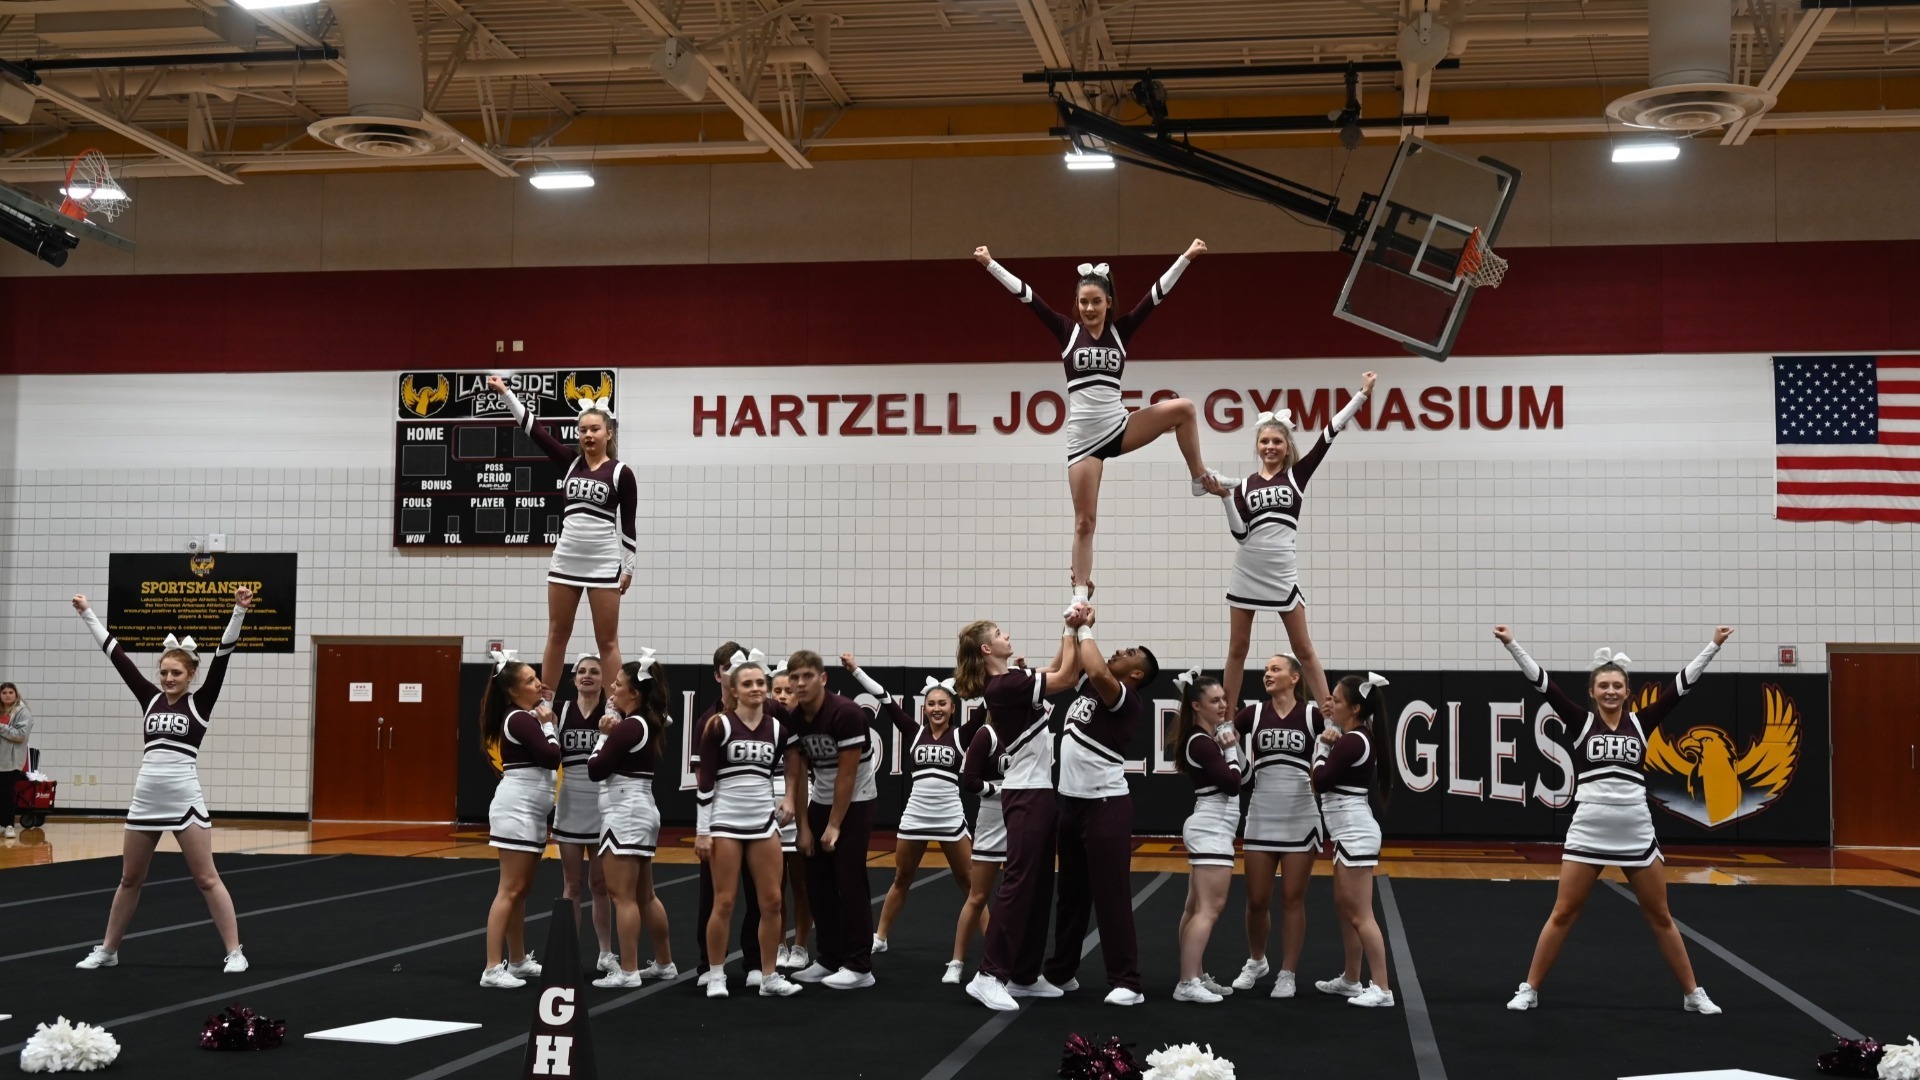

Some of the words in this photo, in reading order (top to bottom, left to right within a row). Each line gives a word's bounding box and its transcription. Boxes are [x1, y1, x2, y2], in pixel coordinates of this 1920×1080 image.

[1073, 347, 1122, 372] GHS
[476, 392, 536, 401] GOEN
[475, 400, 536, 414] EAGS
[692, 392, 977, 437] HARTZELL
[1203, 385, 1564, 432] GYMNASIUM
[406, 427, 444, 441] HOME
[484, 463, 504, 472] POSS
[476, 472, 512, 483] PERIOD
[421, 480, 452, 490] BONUS
[566, 477, 610, 505] GHS
[402, 497, 432, 508] FOULS
[470, 497, 505, 508] PLAYER
[515, 497, 546, 508] FOULS
[1246, 485, 1294, 513] GHS
[406, 534, 425, 543] WON
[444, 534, 462, 544] TOL
[504, 534, 529, 544] GAME
[1068, 695, 1098, 725] HS
[145, 712, 190, 736] GHS
[1257, 728, 1306, 753] GHS
[727, 739, 775, 765] GHS
[914, 744, 956, 767] GHS
[1586, 734, 1642, 764] GHS
